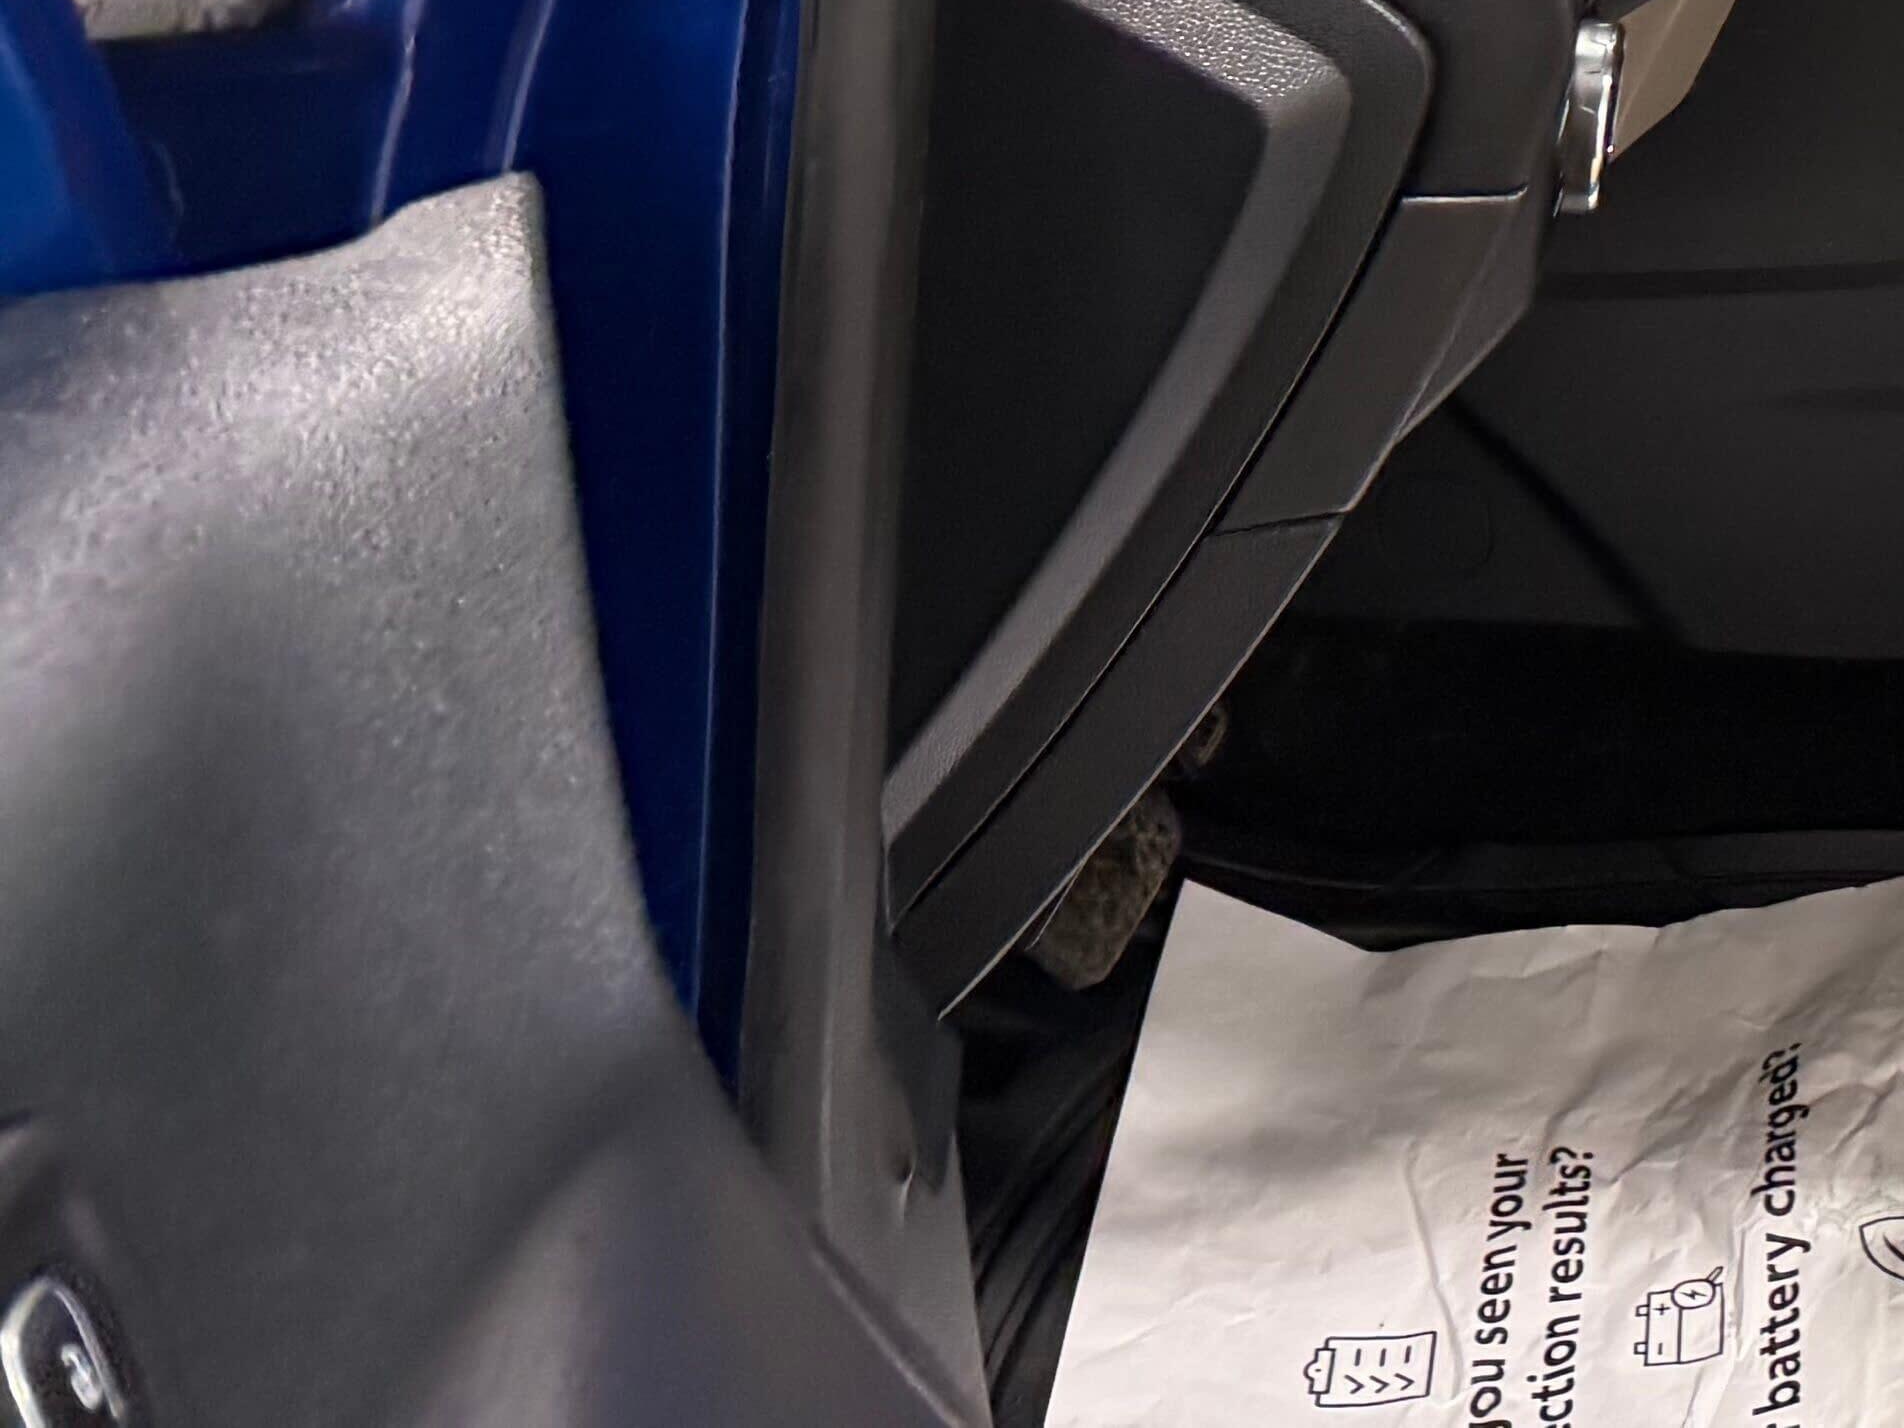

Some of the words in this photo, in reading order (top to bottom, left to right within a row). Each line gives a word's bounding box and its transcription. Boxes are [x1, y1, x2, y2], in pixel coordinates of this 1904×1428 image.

[1487, 1153, 1532, 1241] your
[1751, 1042, 1811, 1217] charged?
[1541, 1146, 1594, 1303] results?
[1477, 1245, 1516, 1346] seen
[1752, 1232, 1812, 1416] battery
[1527, 1314, 1582, 1428] ction
